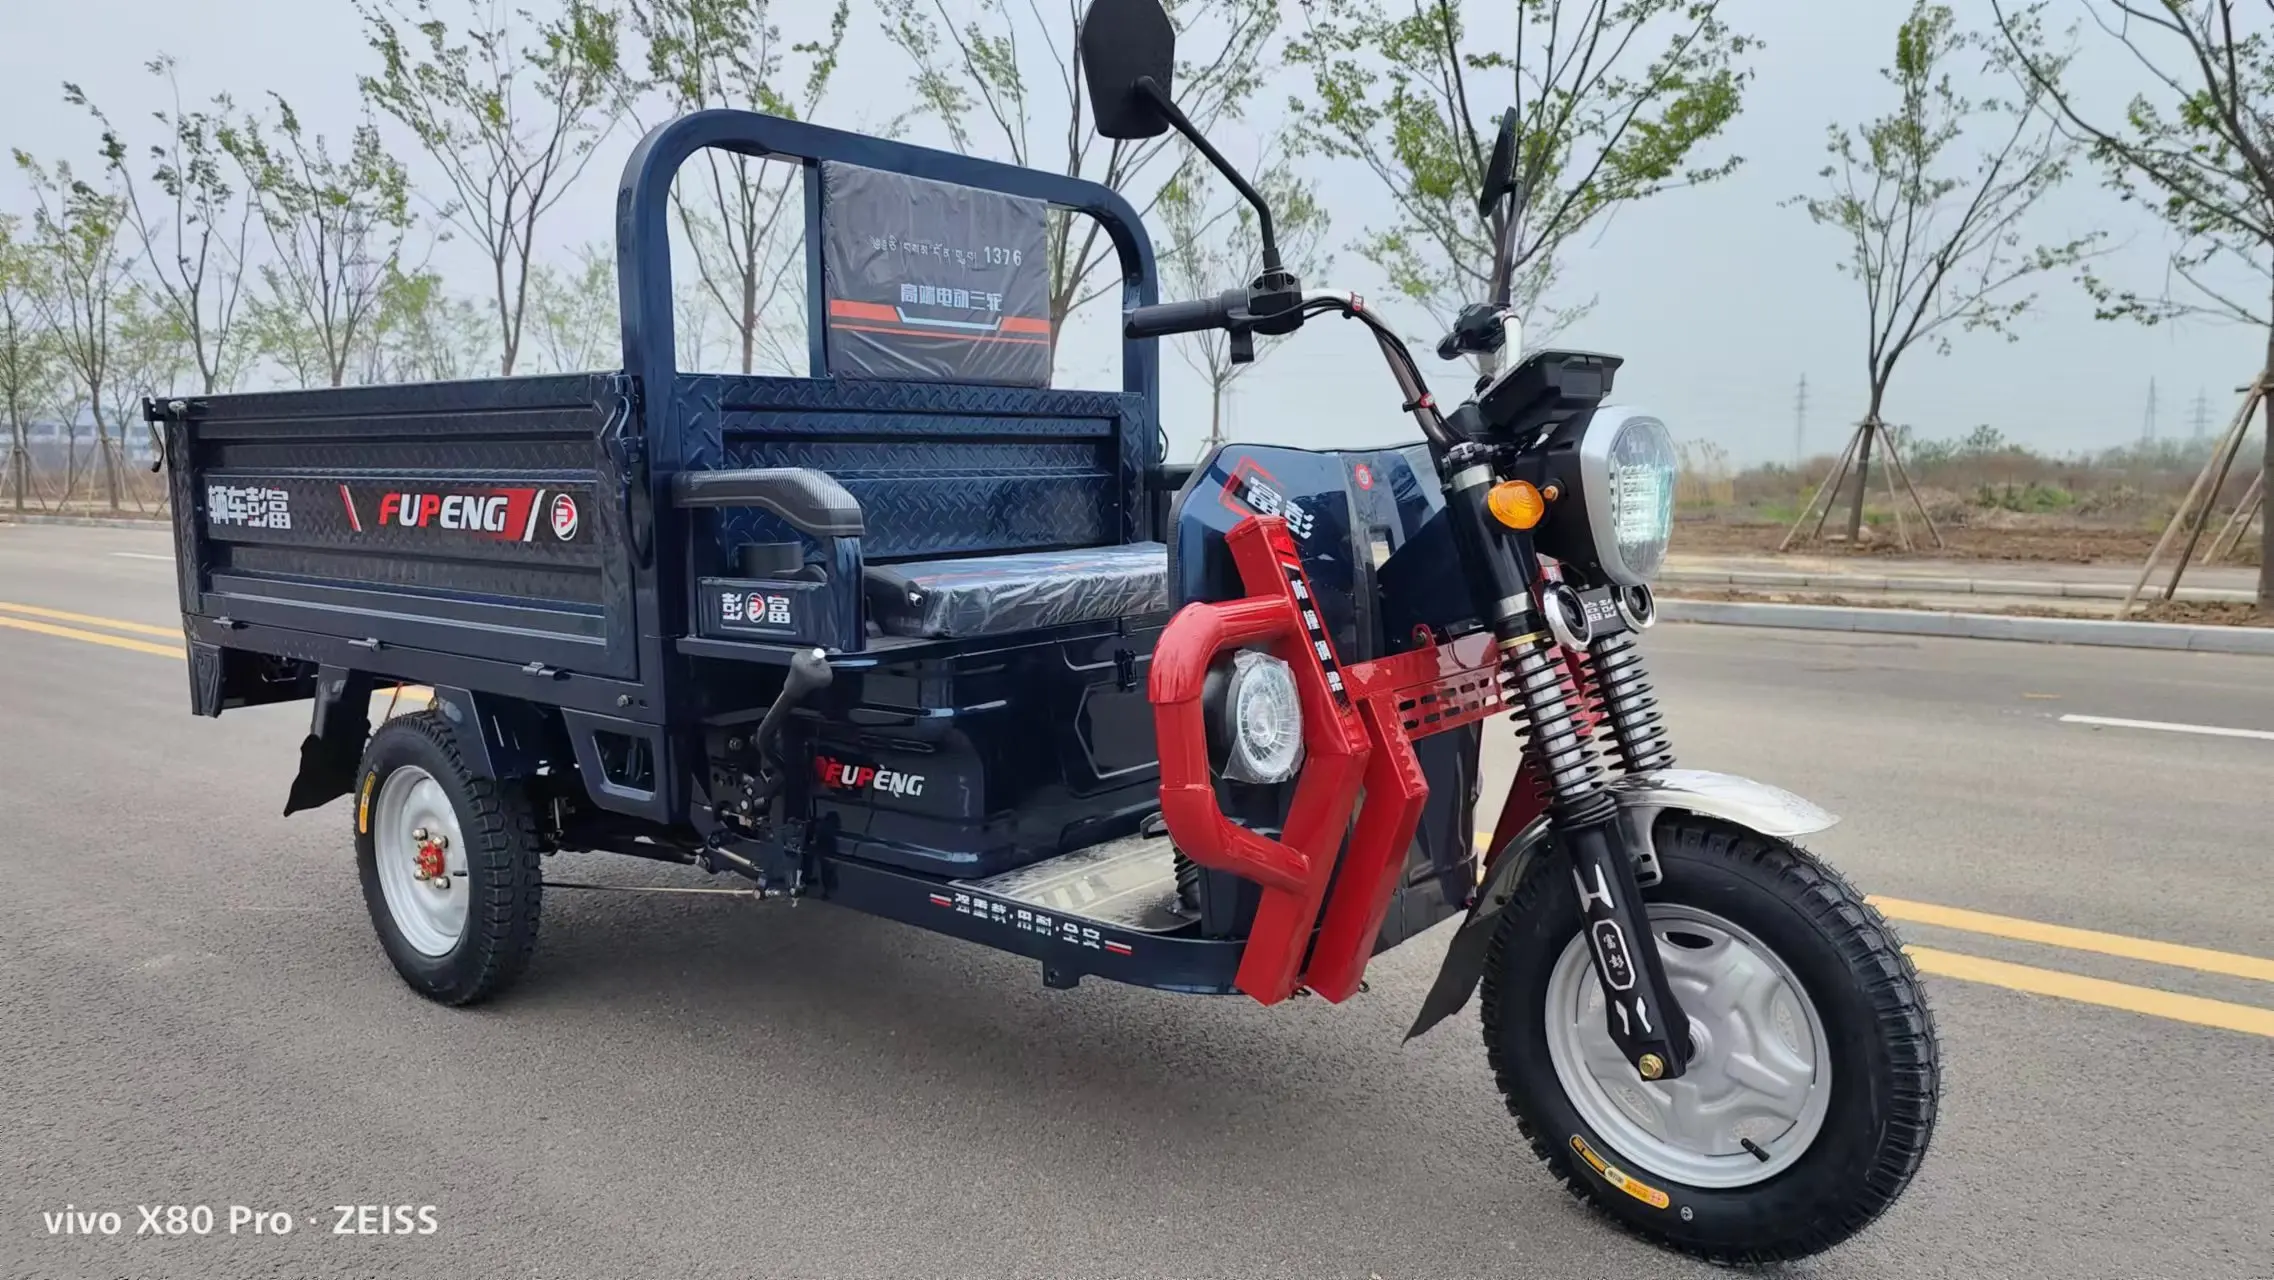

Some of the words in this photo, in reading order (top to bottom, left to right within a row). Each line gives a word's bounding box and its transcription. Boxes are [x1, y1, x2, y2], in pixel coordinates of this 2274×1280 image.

[984, 246, 1022, 266] 1376
[900, 283, 1003, 312] 高端电动三轮
[378, 492, 509, 532] FUPENG
